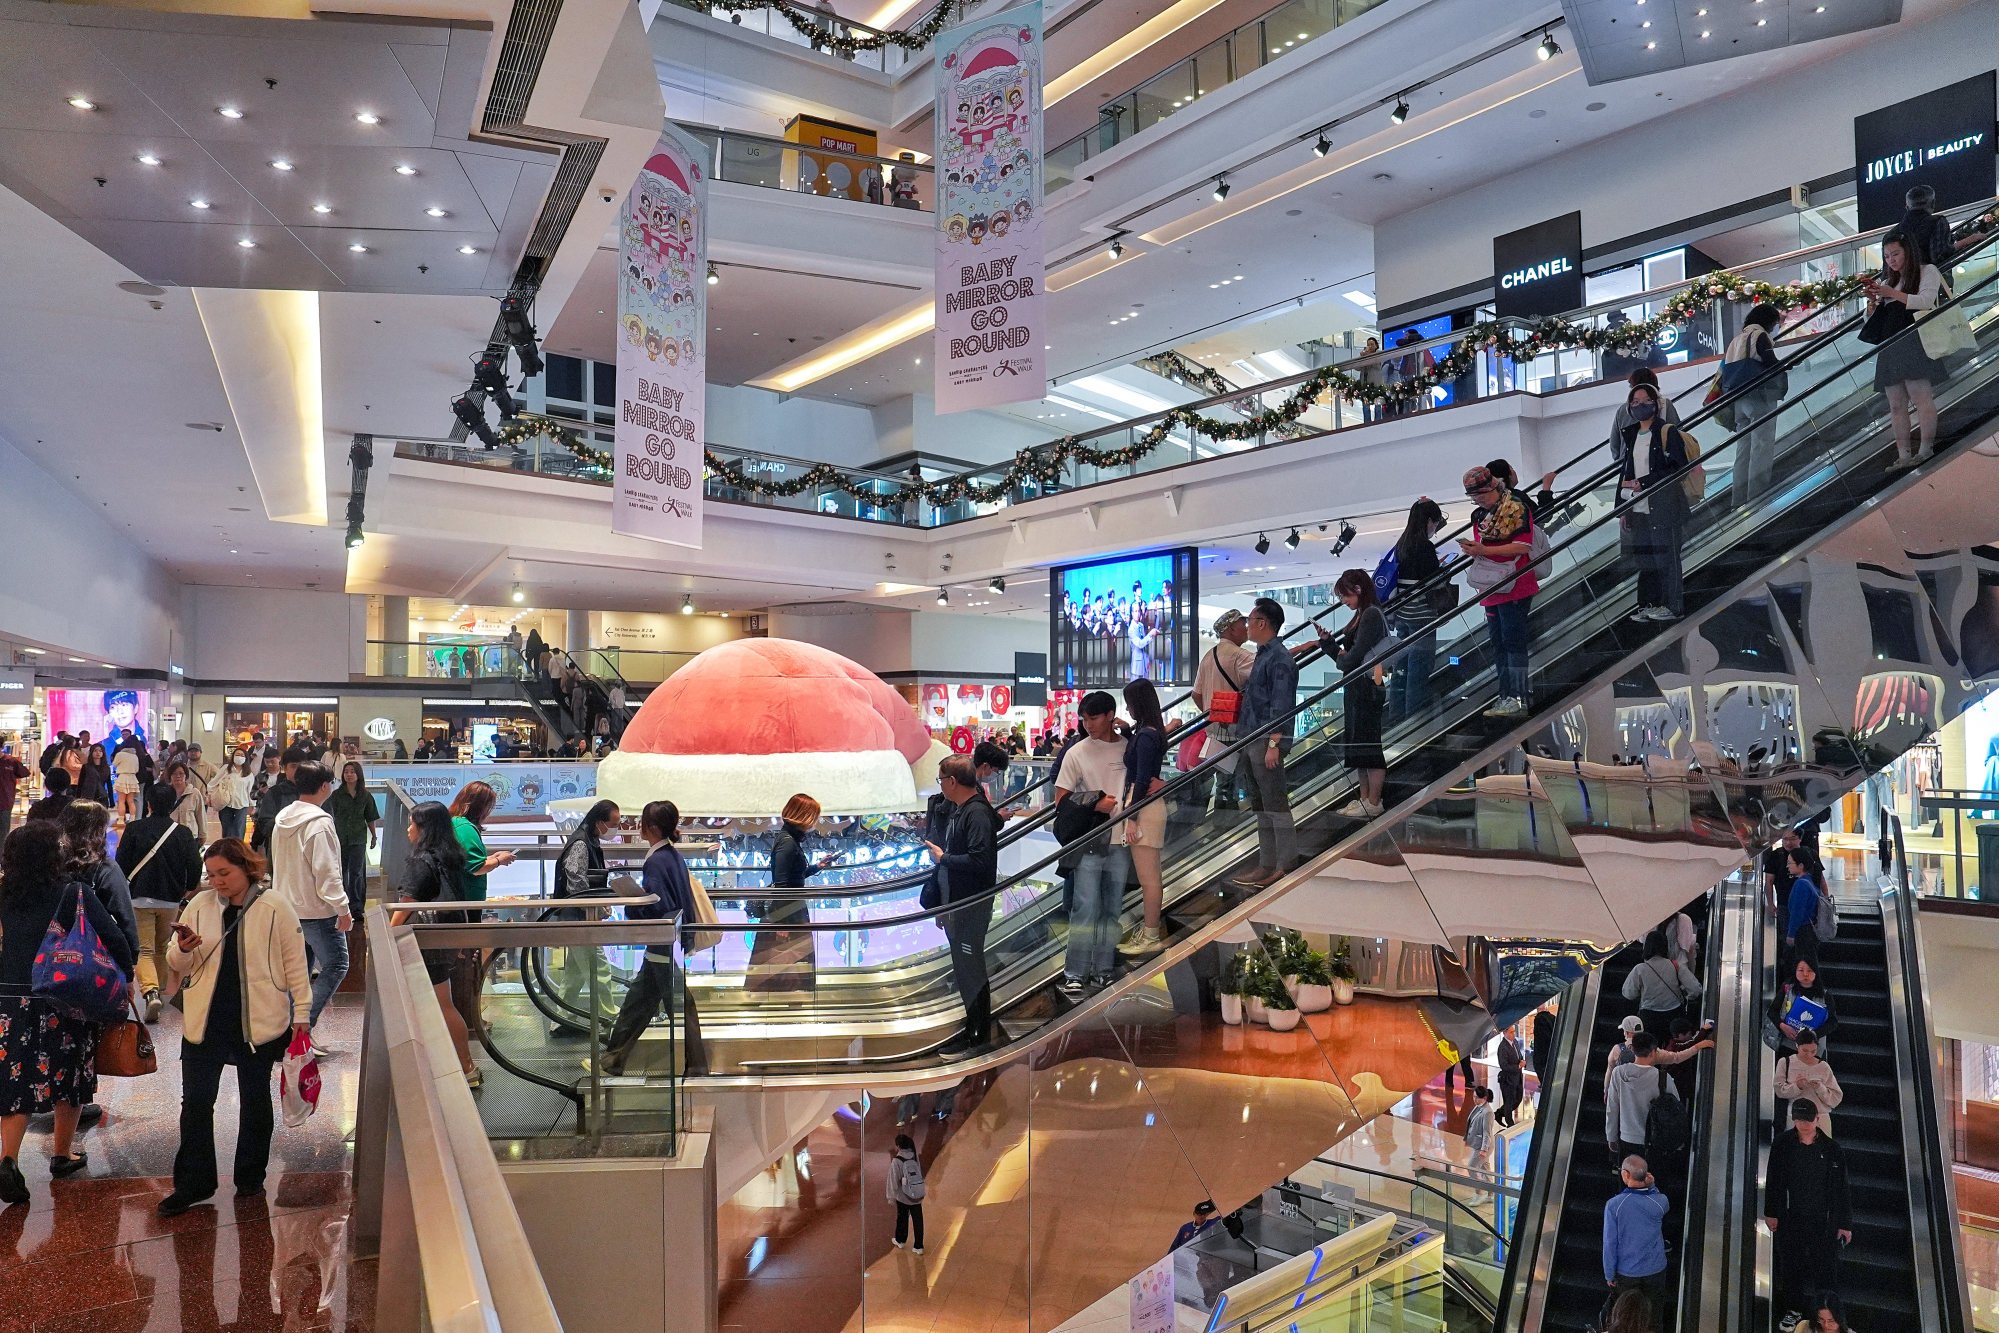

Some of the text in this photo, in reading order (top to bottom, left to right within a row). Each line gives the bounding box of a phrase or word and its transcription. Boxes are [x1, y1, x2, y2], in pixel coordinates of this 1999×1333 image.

[821, 138, 856, 153] POP MART
[1865, 133, 1984, 184] JOYCE BEAUTY
[961, 254, 1018, 287] BABY
[1501, 257, 1573, 289] CHANEL
[946, 276, 1034, 314] MIRROR
[971, 306, 1008, 331] GO
[950, 326, 1030, 359] ROUND
[638, 377, 684, 412] BABY
[623, 399, 695, 442] MIRROR
[645, 433, 675, 460] GO
[626, 453, 692, 490] ROUND
[409, 787, 450, 797] ROUND
[411, 776, 457, 787] MIRROR
